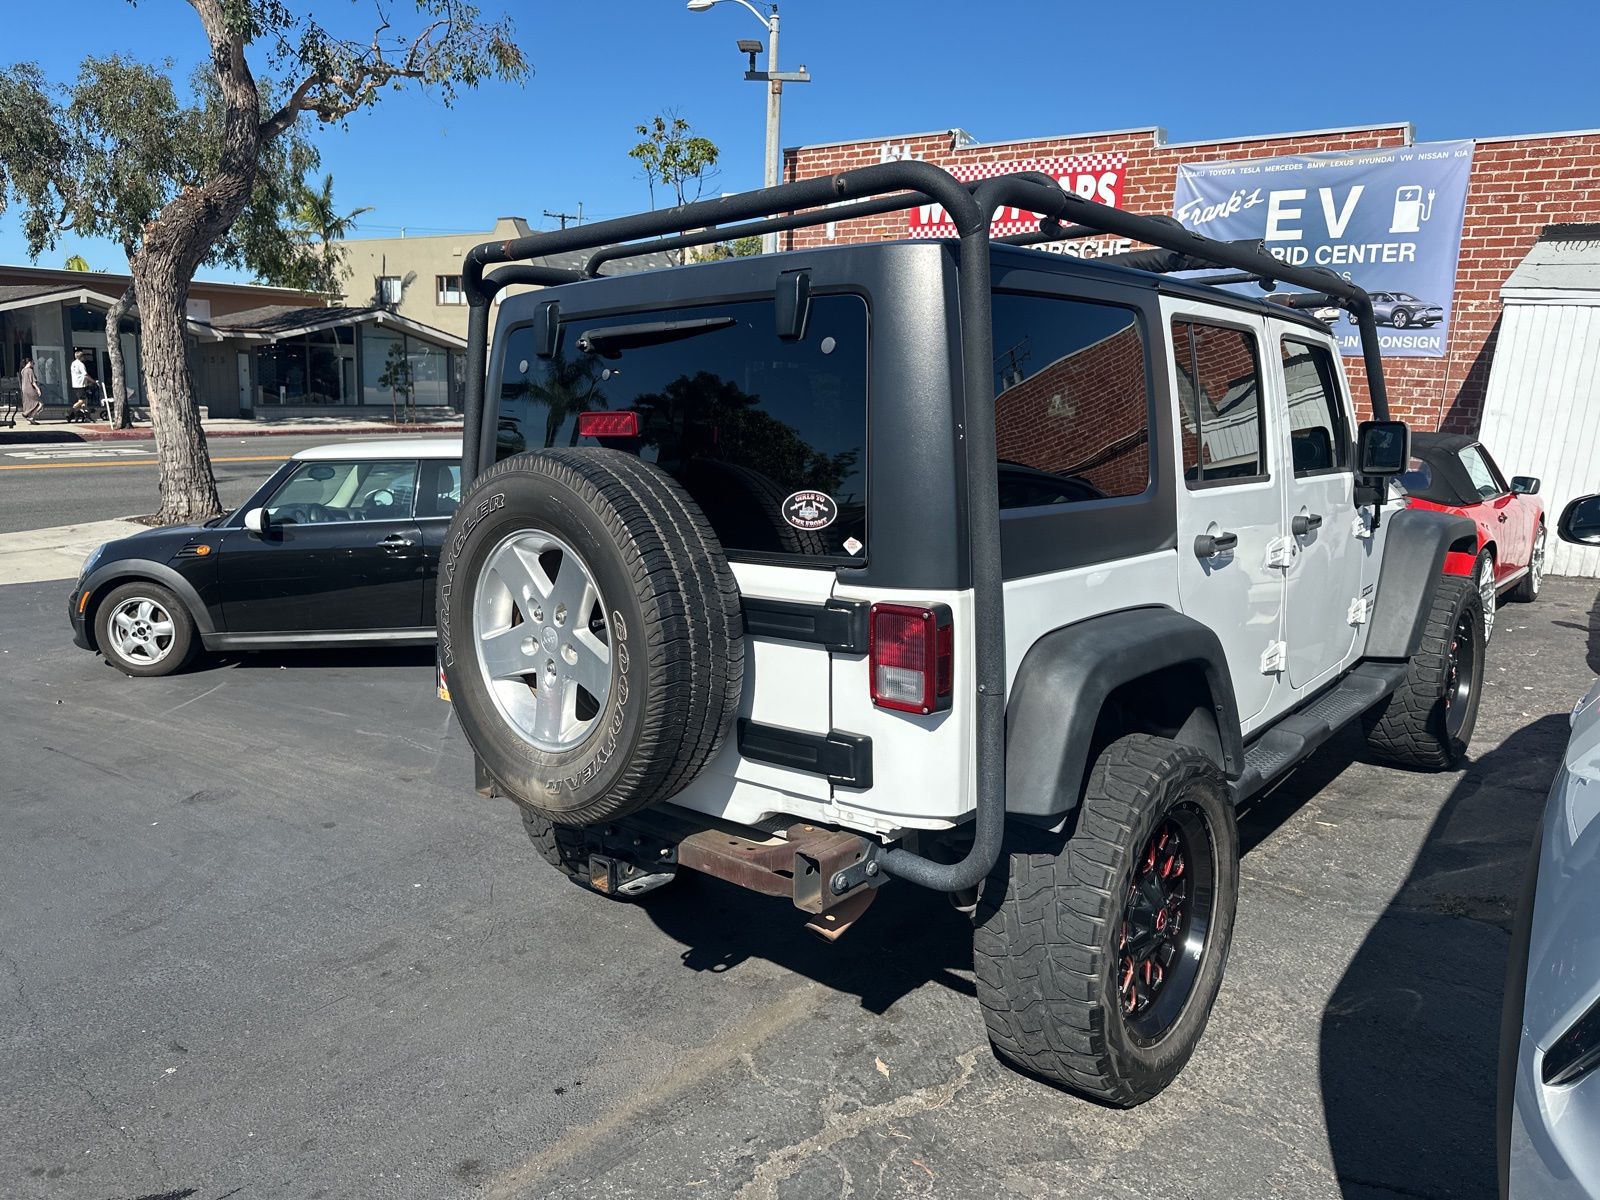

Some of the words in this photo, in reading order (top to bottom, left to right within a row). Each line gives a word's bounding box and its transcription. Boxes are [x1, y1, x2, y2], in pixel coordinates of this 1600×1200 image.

[1209, 168, 1235, 176] TOYOTA
[1240, 166, 1260, 174] TESLA
[1265, 163, 1303, 172] MERCEDES
[1330, 159, 1354, 167] LEXUS
[1358, 155, 1395, 165] HYUNDAI
[1418, 151, 1449, 160] NISSAN
[1454, 150, 1468, 158] KIA
[1177, 188, 1264, 225] Frank's
[1265, 185, 1365, 241] EV
[1314, 242, 1417, 265] CENTER
[1378, 335, 1441, 348] ONSIGN
[795, 493, 815, 502] GIRLS
[441, 492, 505, 667] WRANGLER
[545, 610, 629, 795] GOODYEAR
